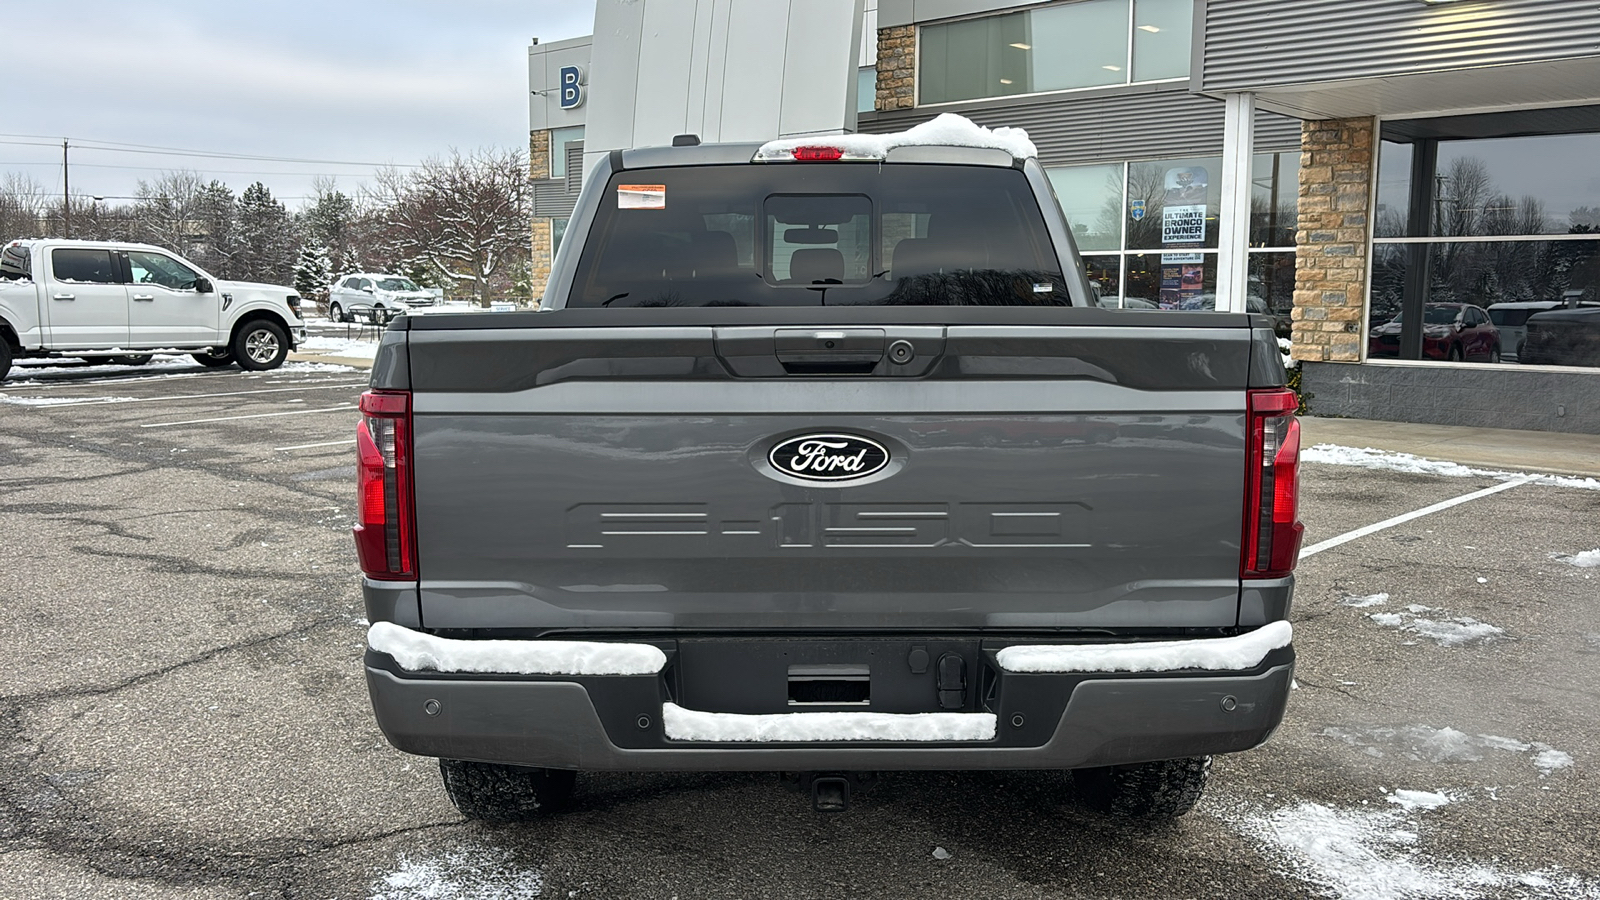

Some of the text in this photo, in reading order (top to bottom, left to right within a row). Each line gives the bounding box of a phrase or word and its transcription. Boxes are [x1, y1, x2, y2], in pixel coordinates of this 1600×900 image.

[560, 65, 584, 109] B
[1164, 219, 1203, 227] BRONCO
[1164, 226, 1203, 235] OWNER
[790, 440, 868, 472] Ford
[565, 501, 1093, 548] F-150
